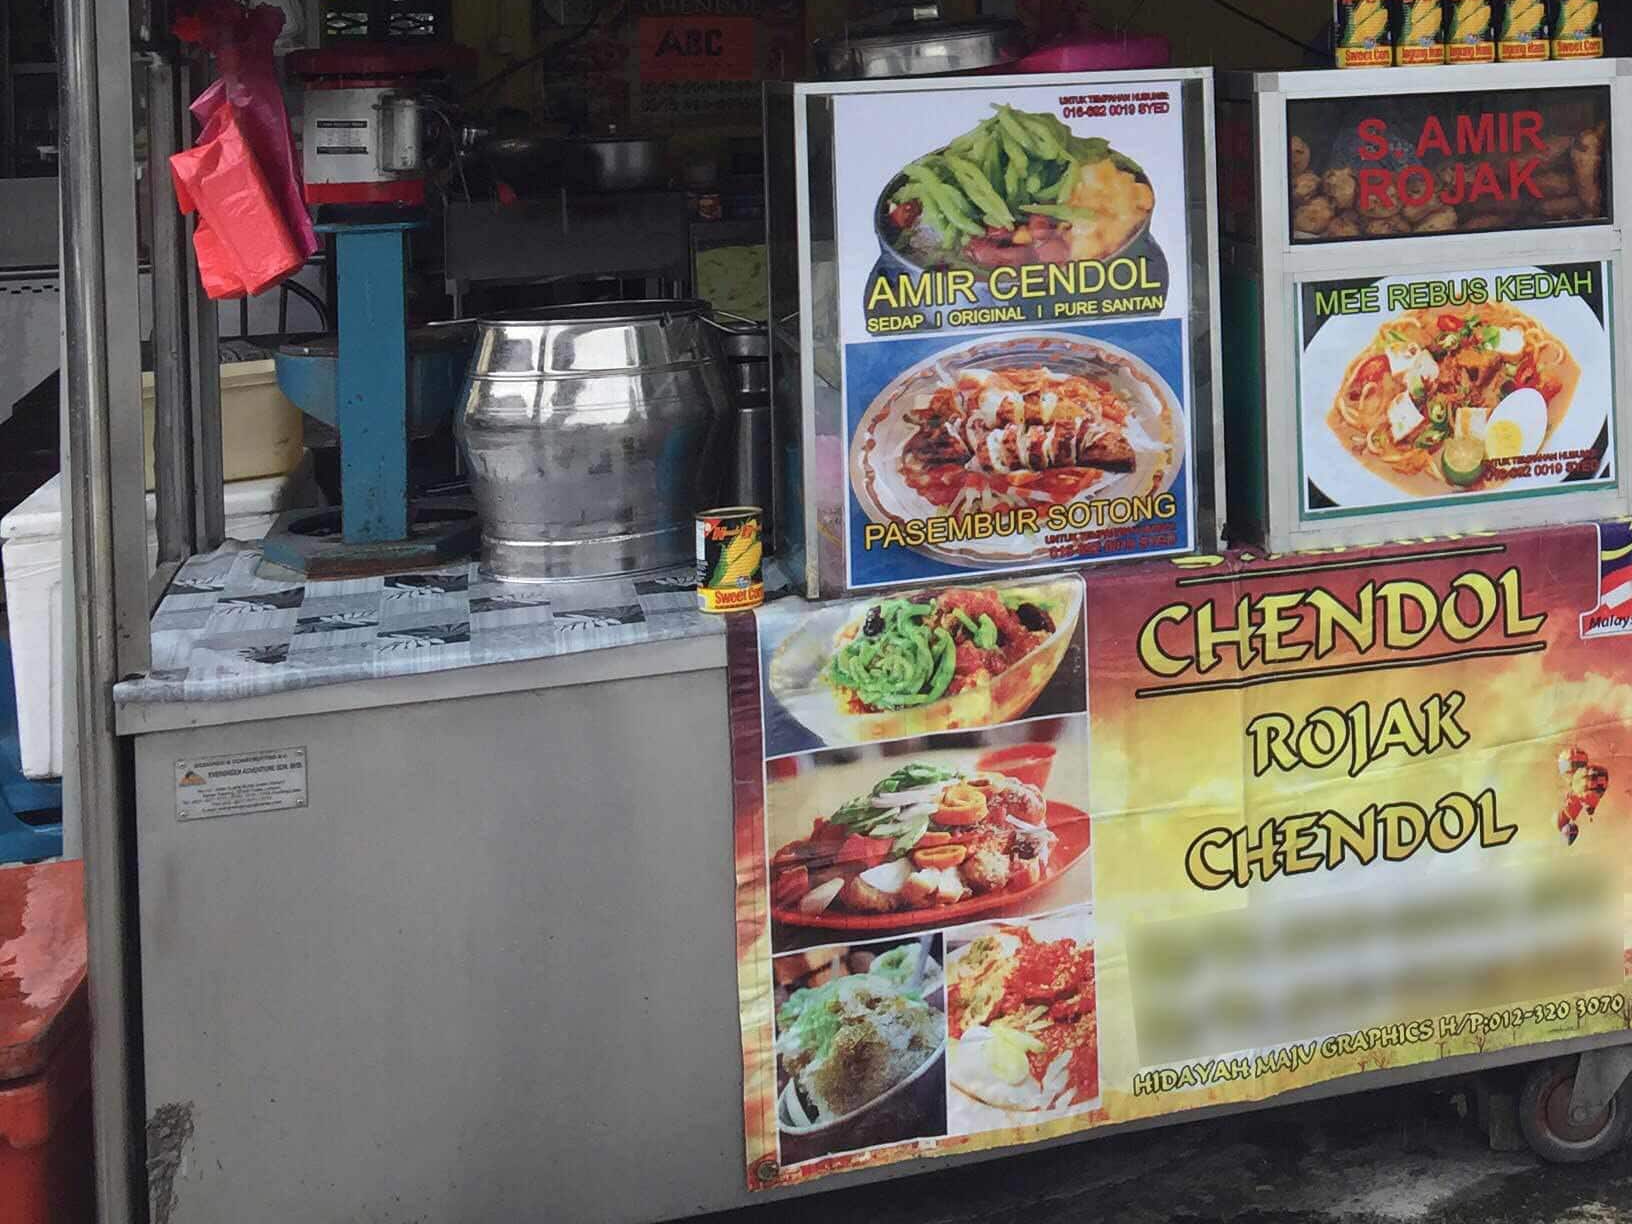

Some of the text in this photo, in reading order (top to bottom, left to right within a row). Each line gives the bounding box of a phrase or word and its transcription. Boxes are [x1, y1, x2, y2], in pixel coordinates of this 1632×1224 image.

[655, 28, 724, 58] ABC
[1357, 110, 1547, 162] S. AMIR
[1358, 158, 1545, 211] ROJAK
[867, 256, 1161, 310] AMIR CENDOL
[1314, 270, 1594, 317] MEE REBUS KEDAH
[866, 313, 925, 333] SEDAP
[948, 306, 1026, 328] ORIGINAL
[1054, 298, 1098, 317] PURE
[1101, 295, 1164, 314] SANTAN
[863, 511, 1039, 551] PASEMBUR
[1045, 491, 1178, 531] SOTONG
[714, 588, 747, 605] Sweet
[1136, 568, 1548, 678] CHENDOL
[1247, 690, 1472, 777] ROJAK
[1185, 788, 1519, 891] CHENDOL
[1132, 1055, 1252, 1098] HIDAYAH
[1254, 1040, 1318, 1078] MAJU
[1319, 1019, 1434, 1059] GRAPHICS
[1575, 992, 1625, 1017] 3070
